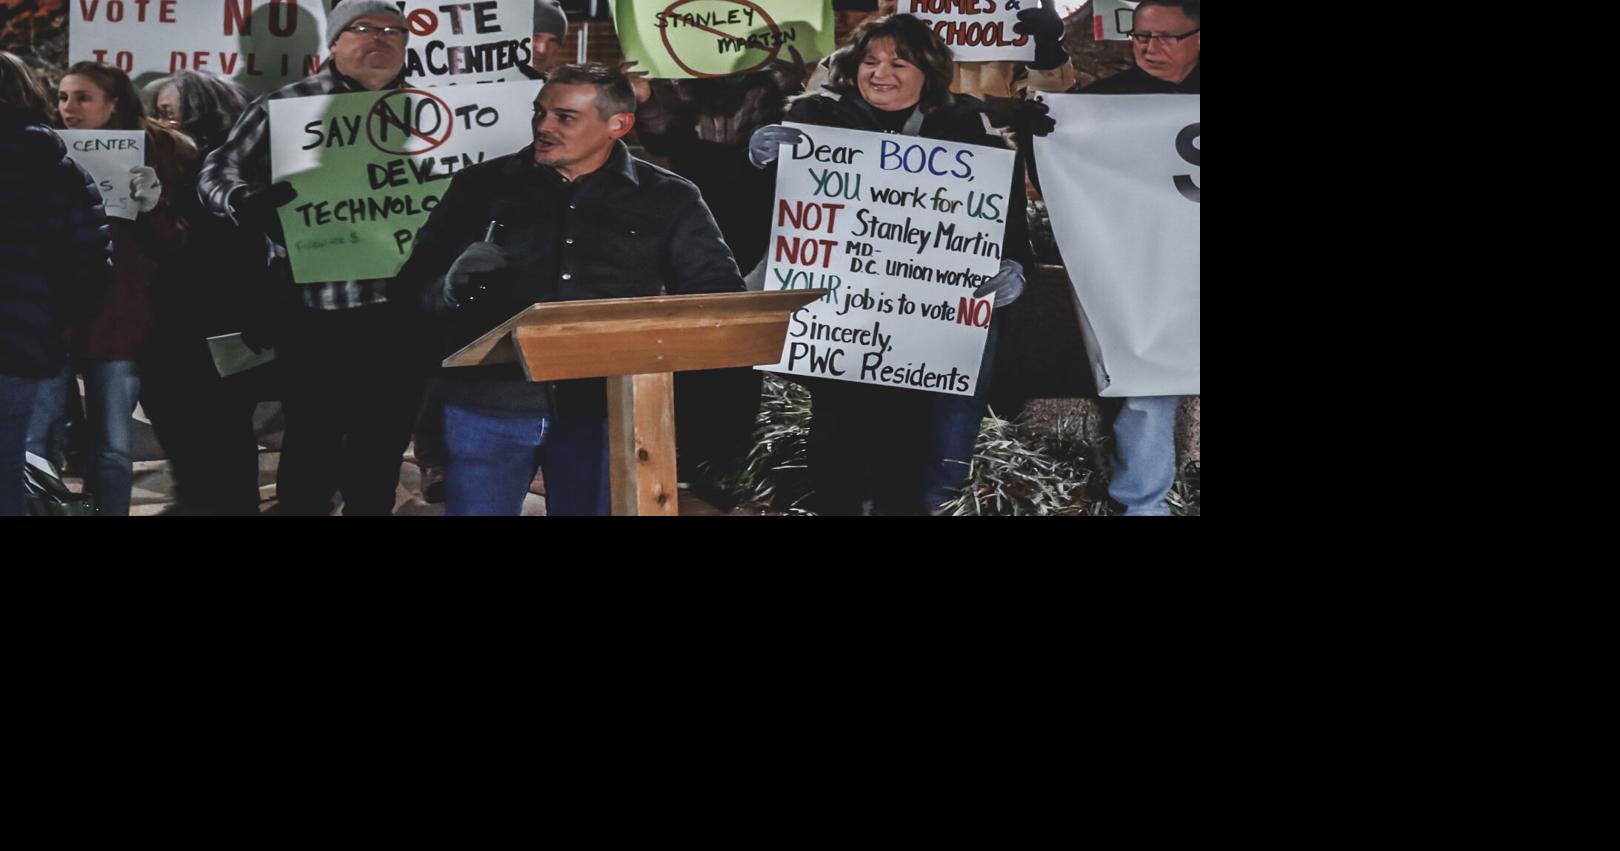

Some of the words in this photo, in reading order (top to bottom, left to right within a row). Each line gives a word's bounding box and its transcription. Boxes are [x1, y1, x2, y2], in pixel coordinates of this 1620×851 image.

[80, 0, 177, 23] VOTE
[223, 0, 298, 37] NO
[396, 1, 502, 36] OTE
[654, 8, 755, 28] STANLEY
[426, 38, 531, 76] CENTERS
[718, 28, 796, 53] MARTIN
[170, 51, 320, 77] DEVLIN
[302, 115, 361, 150] SAY
[376, 97, 441, 142] NO
[455, 104, 499, 130] TO
[73, 138, 139, 151] CENTER
[792, 132, 864, 165] Dear
[880, 140, 975, 182] BOCS,
[808, 168, 861, 201] YOU
[870, 186, 926, 209] work
[931, 187, 963, 214] for
[778, 199, 845, 234] NOT
[851, 208, 931, 254] Stanley
[775, 235, 838, 269] NOT
[885, 258, 933, 282] union
[836, 286, 875, 315] job
[877, 292, 894, 313] is
[898, 293, 916, 315] to
[921, 301, 956, 321] vote
[789, 307, 892, 352] Sincerely,
[788, 342, 845, 377] PWC
[860, 352, 970, 392] Residents
